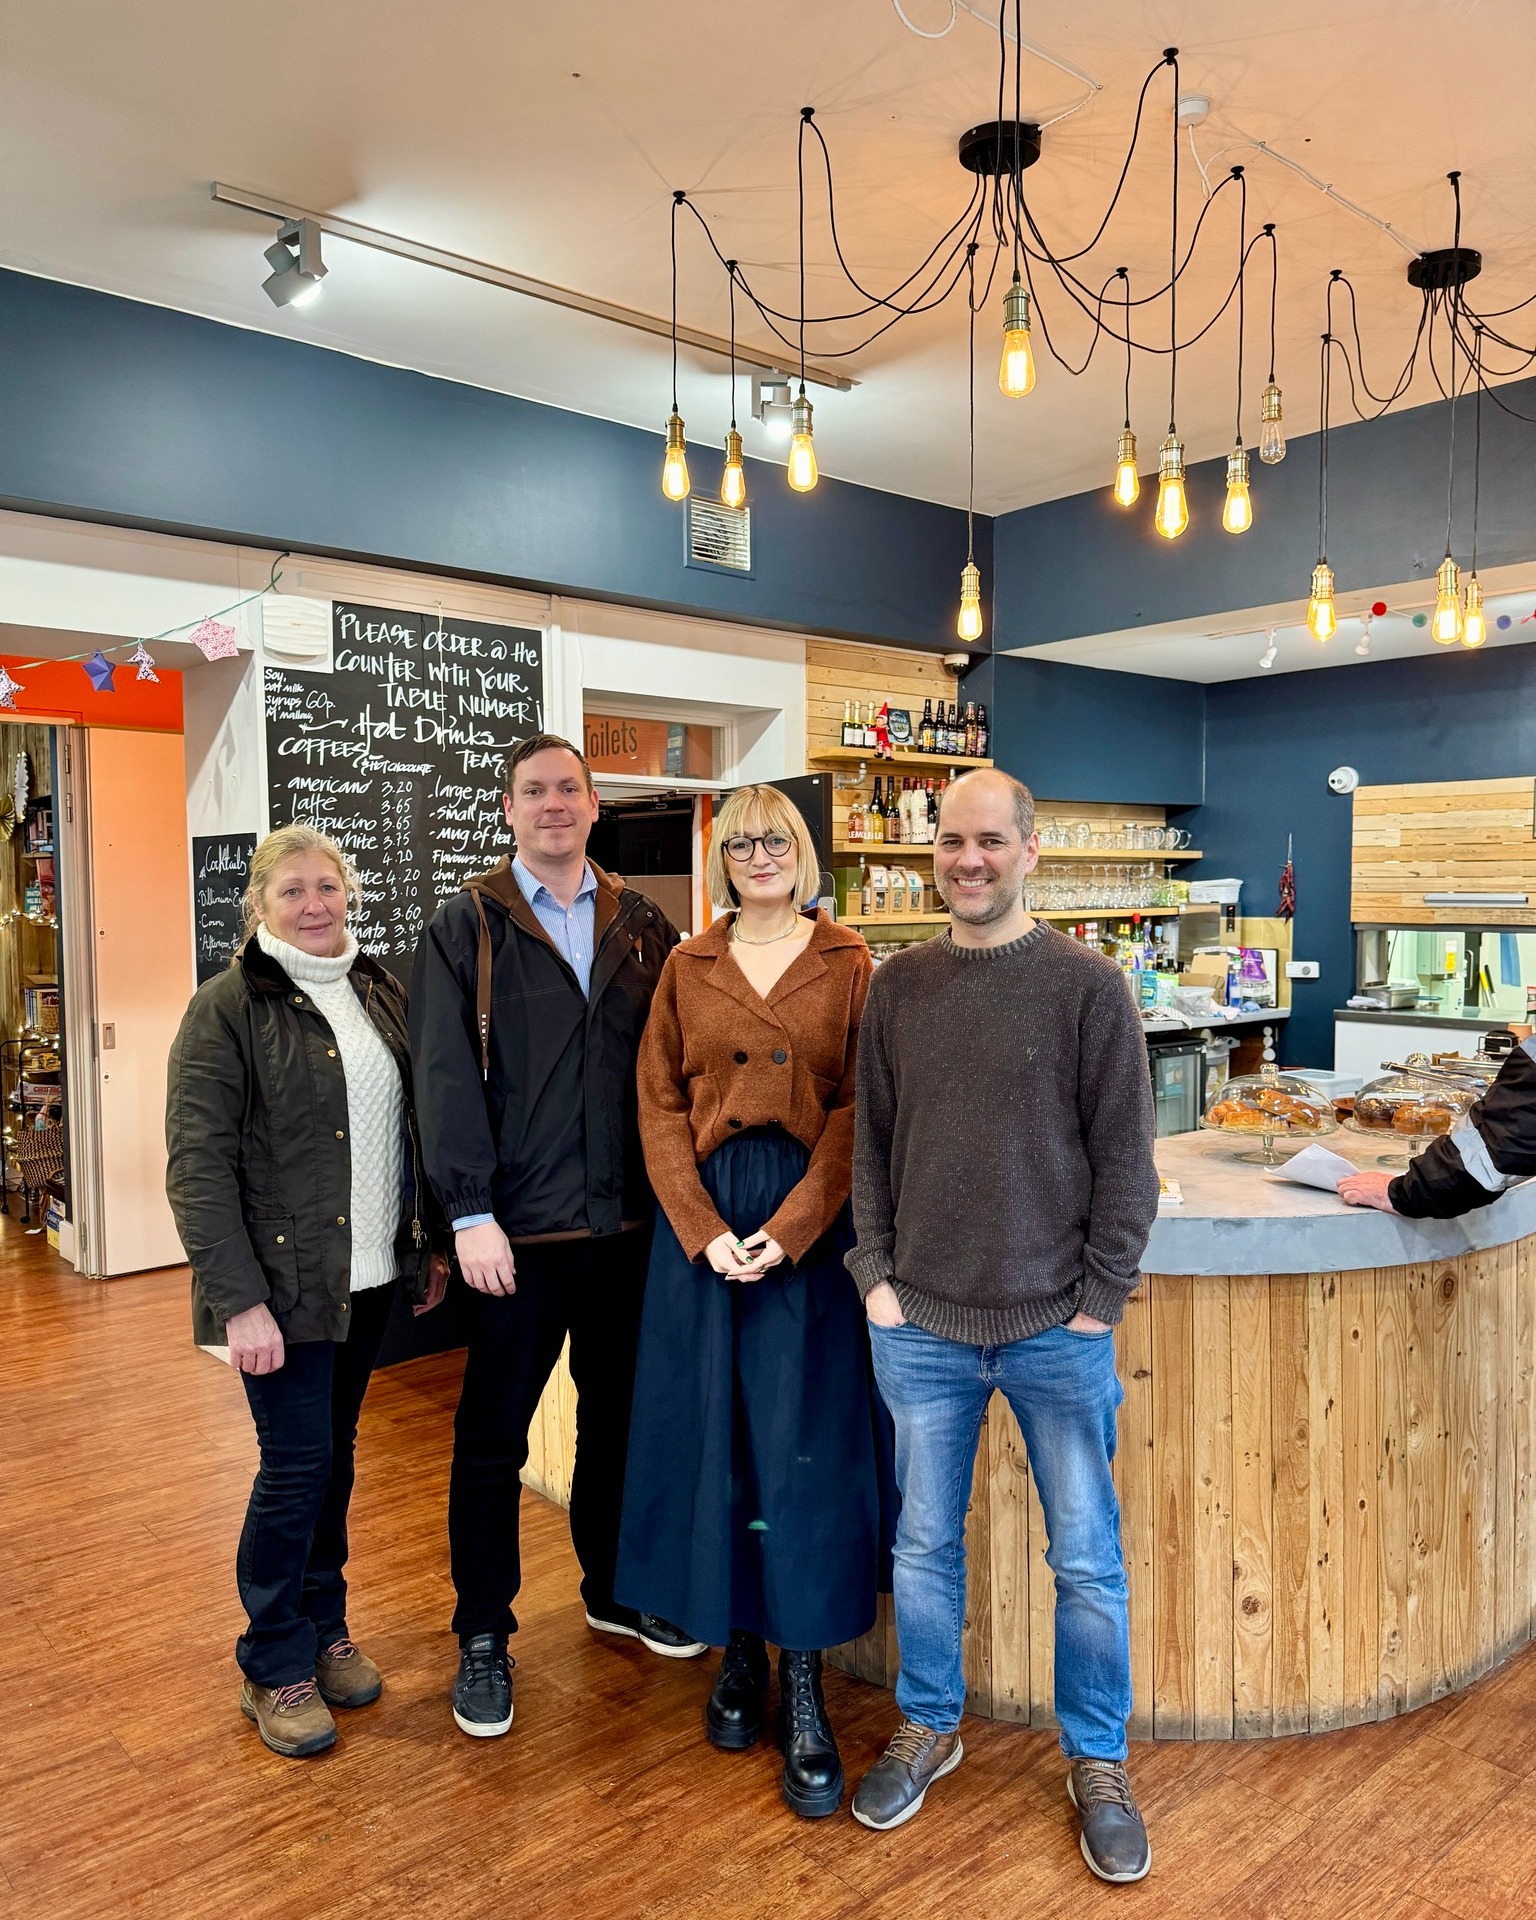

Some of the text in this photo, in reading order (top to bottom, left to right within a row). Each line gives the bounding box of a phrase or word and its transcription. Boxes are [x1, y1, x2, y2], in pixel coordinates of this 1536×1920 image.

[423, 631, 488, 658] ORDER
[491, 640, 508, 660] @
[510, 641, 539, 667] the
[335, 649, 529, 699] COUNTER WITH YOUR
[264, 681, 304, 693] oat milk
[377, 682, 448, 711] TABLE
[265, 695, 302, 711] syrups
[352, 703, 508, 753] Hot Drinks
[584, 721, 637, 759] Toilets
[278, 737, 370, 768] COFFEES
[288, 776, 413, 797] americano 3.20
[435, 775, 502, 811] large pot
[292, 793, 413, 818] latte 3.65
[437, 803, 504, 829] small pot
[382, 815, 412, 832] 3.65
[331, 831, 411, 850] white 3.75
[473, 826, 492, 849] of
[492, 827, 511, 846] tea
[206, 844, 247, 876] Cocktails
[382, 849, 413, 866] 4.20
[386, 869, 420, 885] 4.20
[391, 886, 417, 901] 3.10
[201, 913, 225, 928] Cosmo
[390, 904, 421, 921] 3.60
[394, 920, 423, 937] 3.40
[395, 937, 419, 955] 3.7
